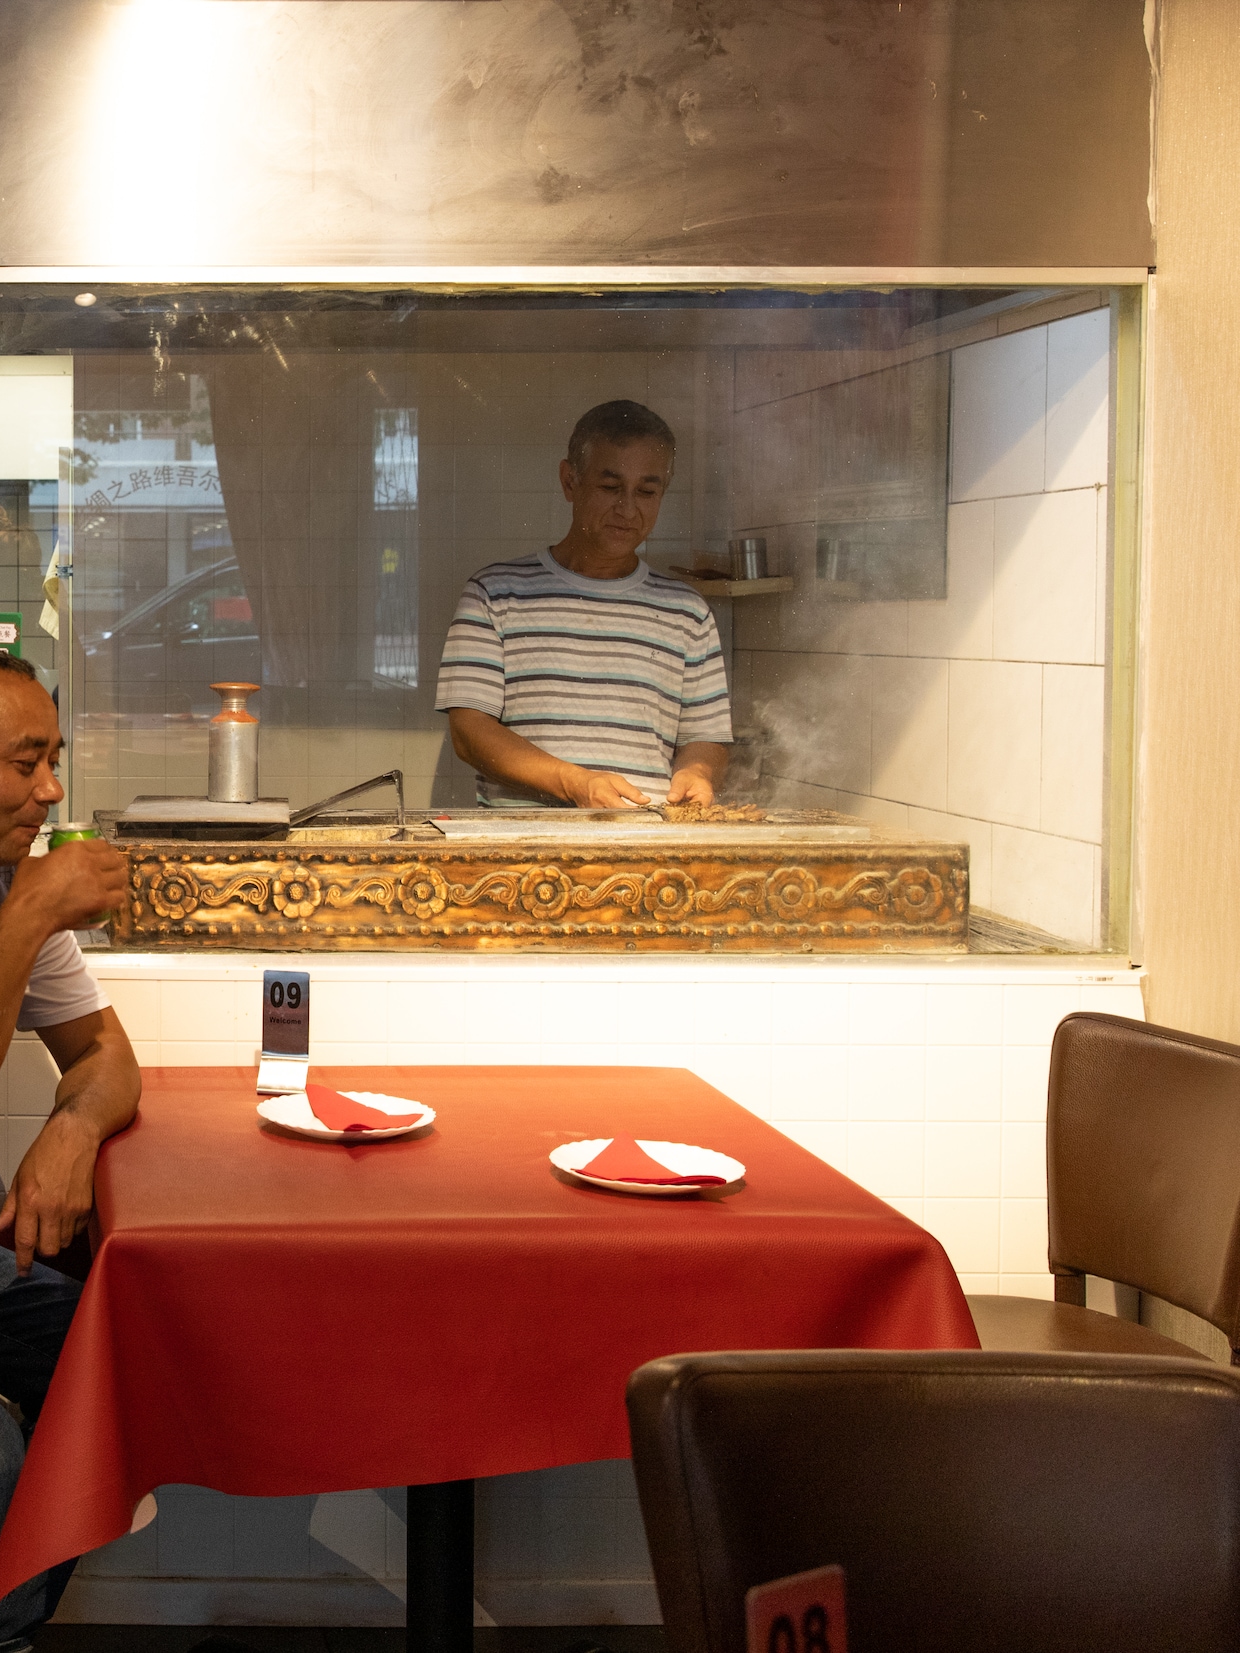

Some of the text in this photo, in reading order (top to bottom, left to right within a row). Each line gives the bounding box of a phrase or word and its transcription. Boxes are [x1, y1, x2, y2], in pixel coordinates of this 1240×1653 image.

[78, 465, 223, 512] 绸之路维吾尔
[270, 981, 302, 1009] 09
[270, 1017, 302, 1025] Welcome
[768, 1604, 828, 1653] 08
